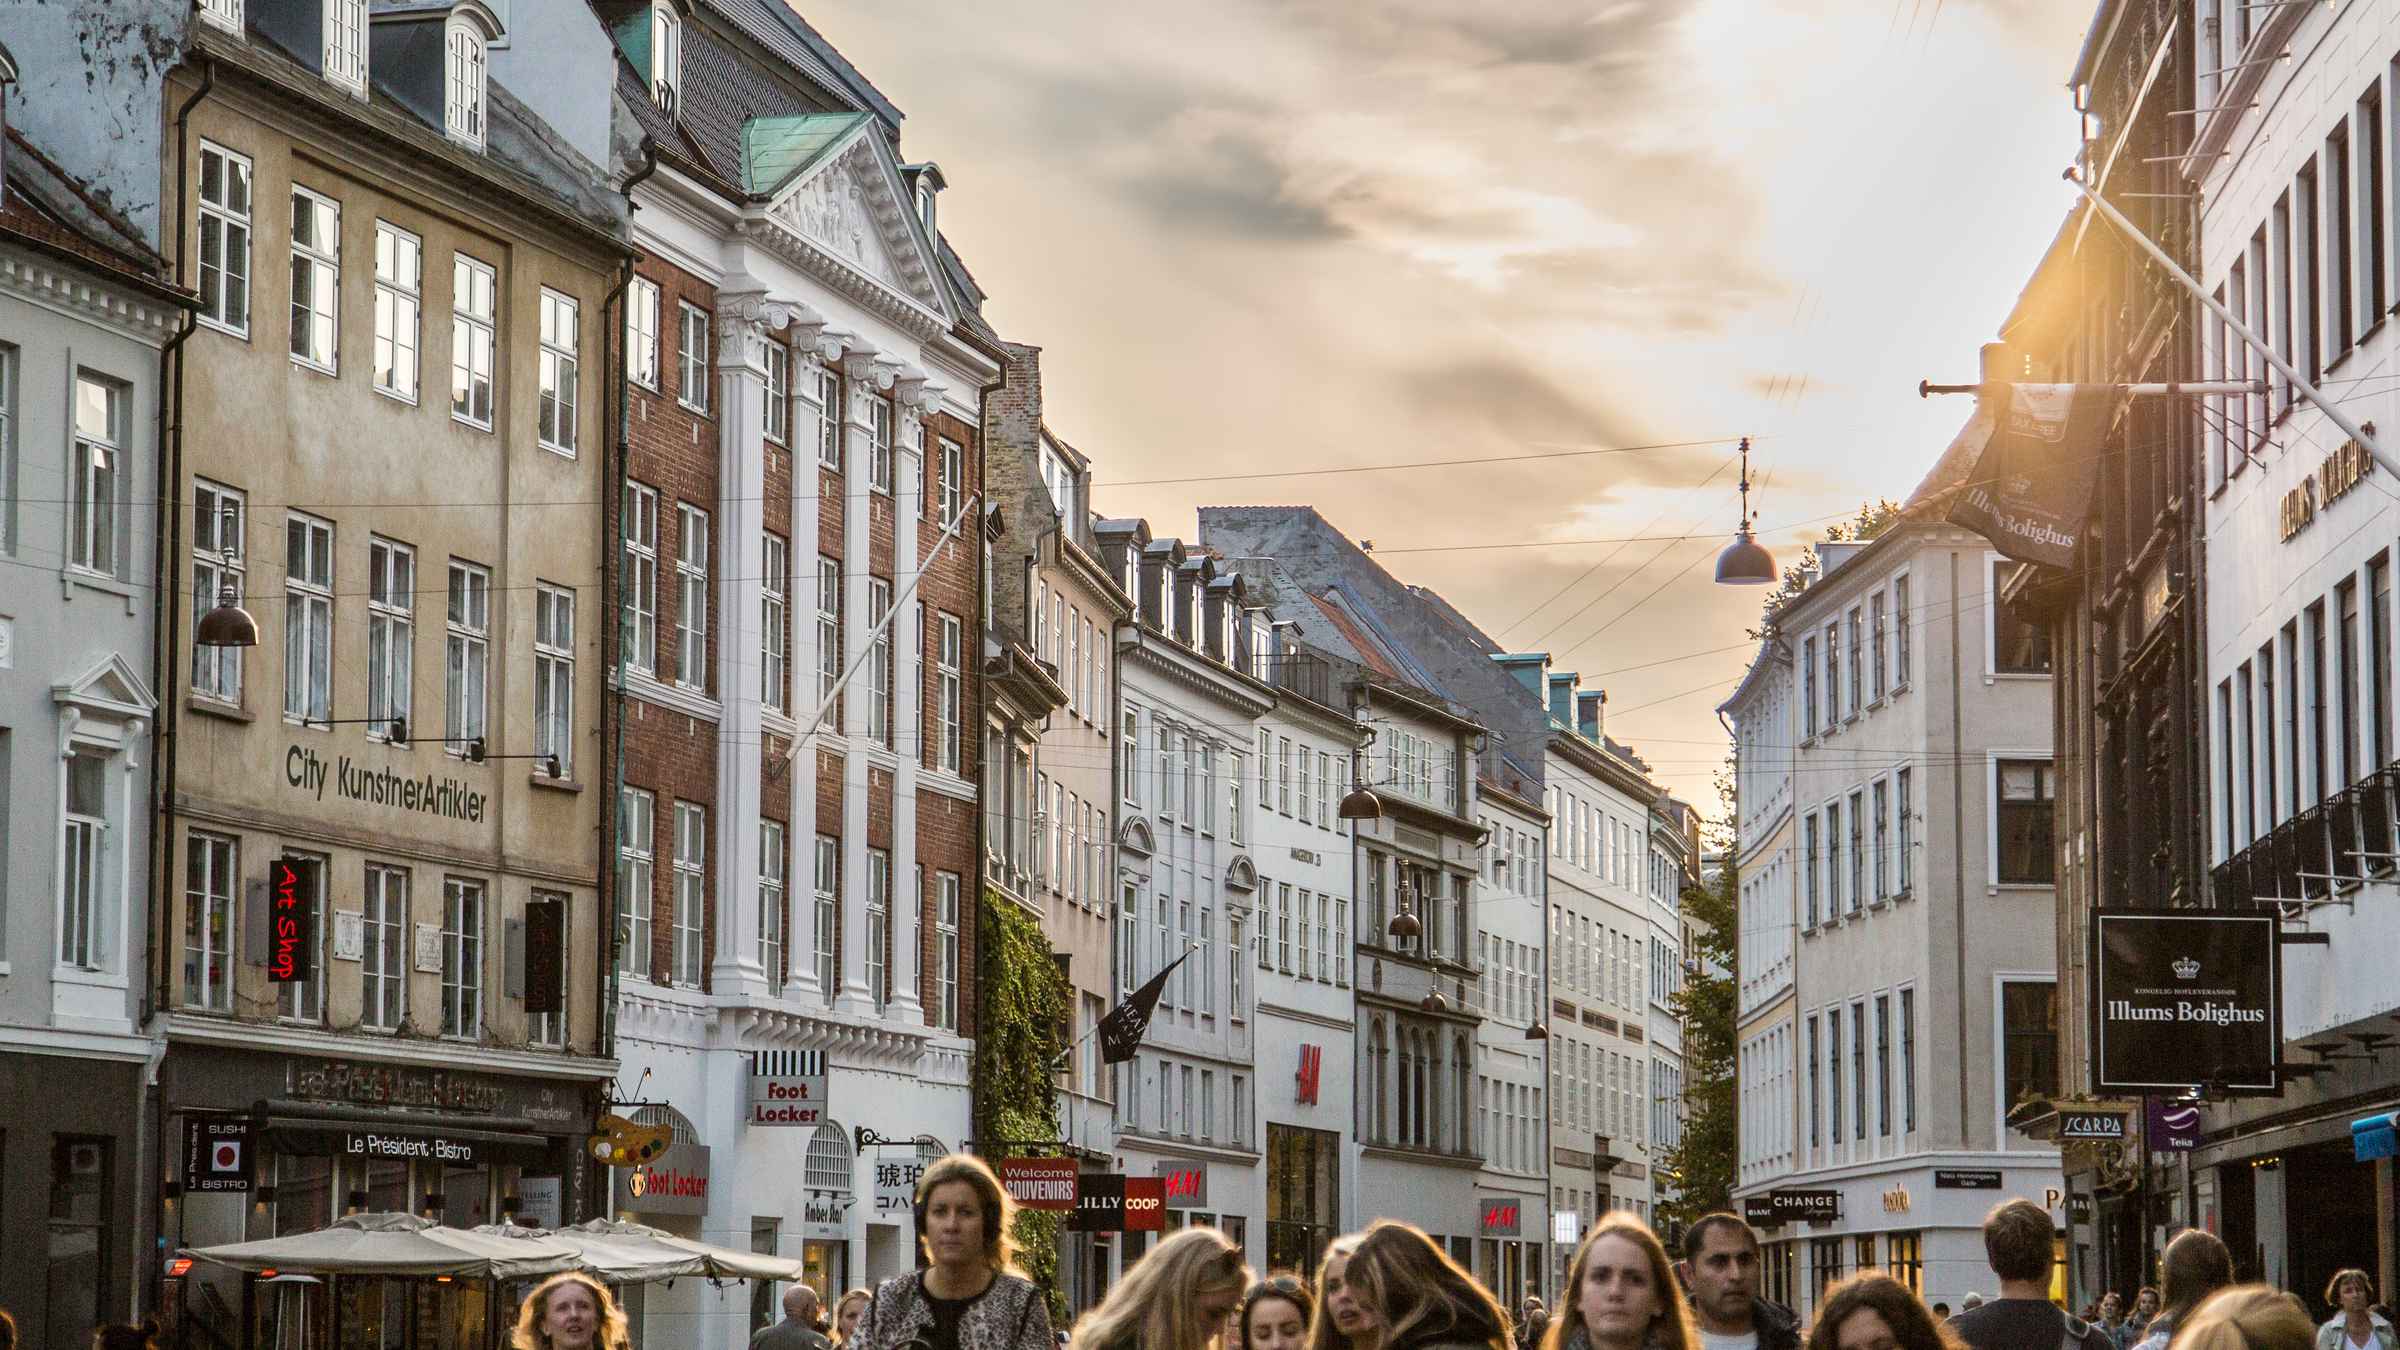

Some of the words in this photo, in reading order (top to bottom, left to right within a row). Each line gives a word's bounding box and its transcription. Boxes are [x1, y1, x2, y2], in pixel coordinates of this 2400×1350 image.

[286, 744, 328, 801] City
[338, 755, 487, 823] KunstnerArtikler
[278, 864, 297, 910] Art
[270, 915, 300, 979] Shop
[2108, 1000, 2174, 1021] Illums
[2177, 1001, 2265, 1026] Bolighus
[767, 1082, 808, 1099] Foot
[756, 1105, 819, 1122] Locker
[208, 1125, 247, 1134] SUSHI
[2064, 1116, 2122, 1133] SCARPA
[347, 1133, 364, 1153] Le
[367, 1135, 430, 1157] Président
[435, 1139, 472, 1160] Bistro
[2169, 1137, 2193, 1147] Telia
[876, 1163, 925, 1188] 琥珀
[1005, 1167, 1074, 1178] Welcome
[202, 1180, 249, 1190] BISTRO
[647, 1167, 670, 1195] Foot
[671, 1168, 707, 1198] Locker
[1006, 1180, 1073, 1201] SOUVENIRS
[876, 1196, 909, 1209] コハ
[1125, 1198, 1160, 1210] COOP
[1773, 1196, 1833, 1207] CHANGE
